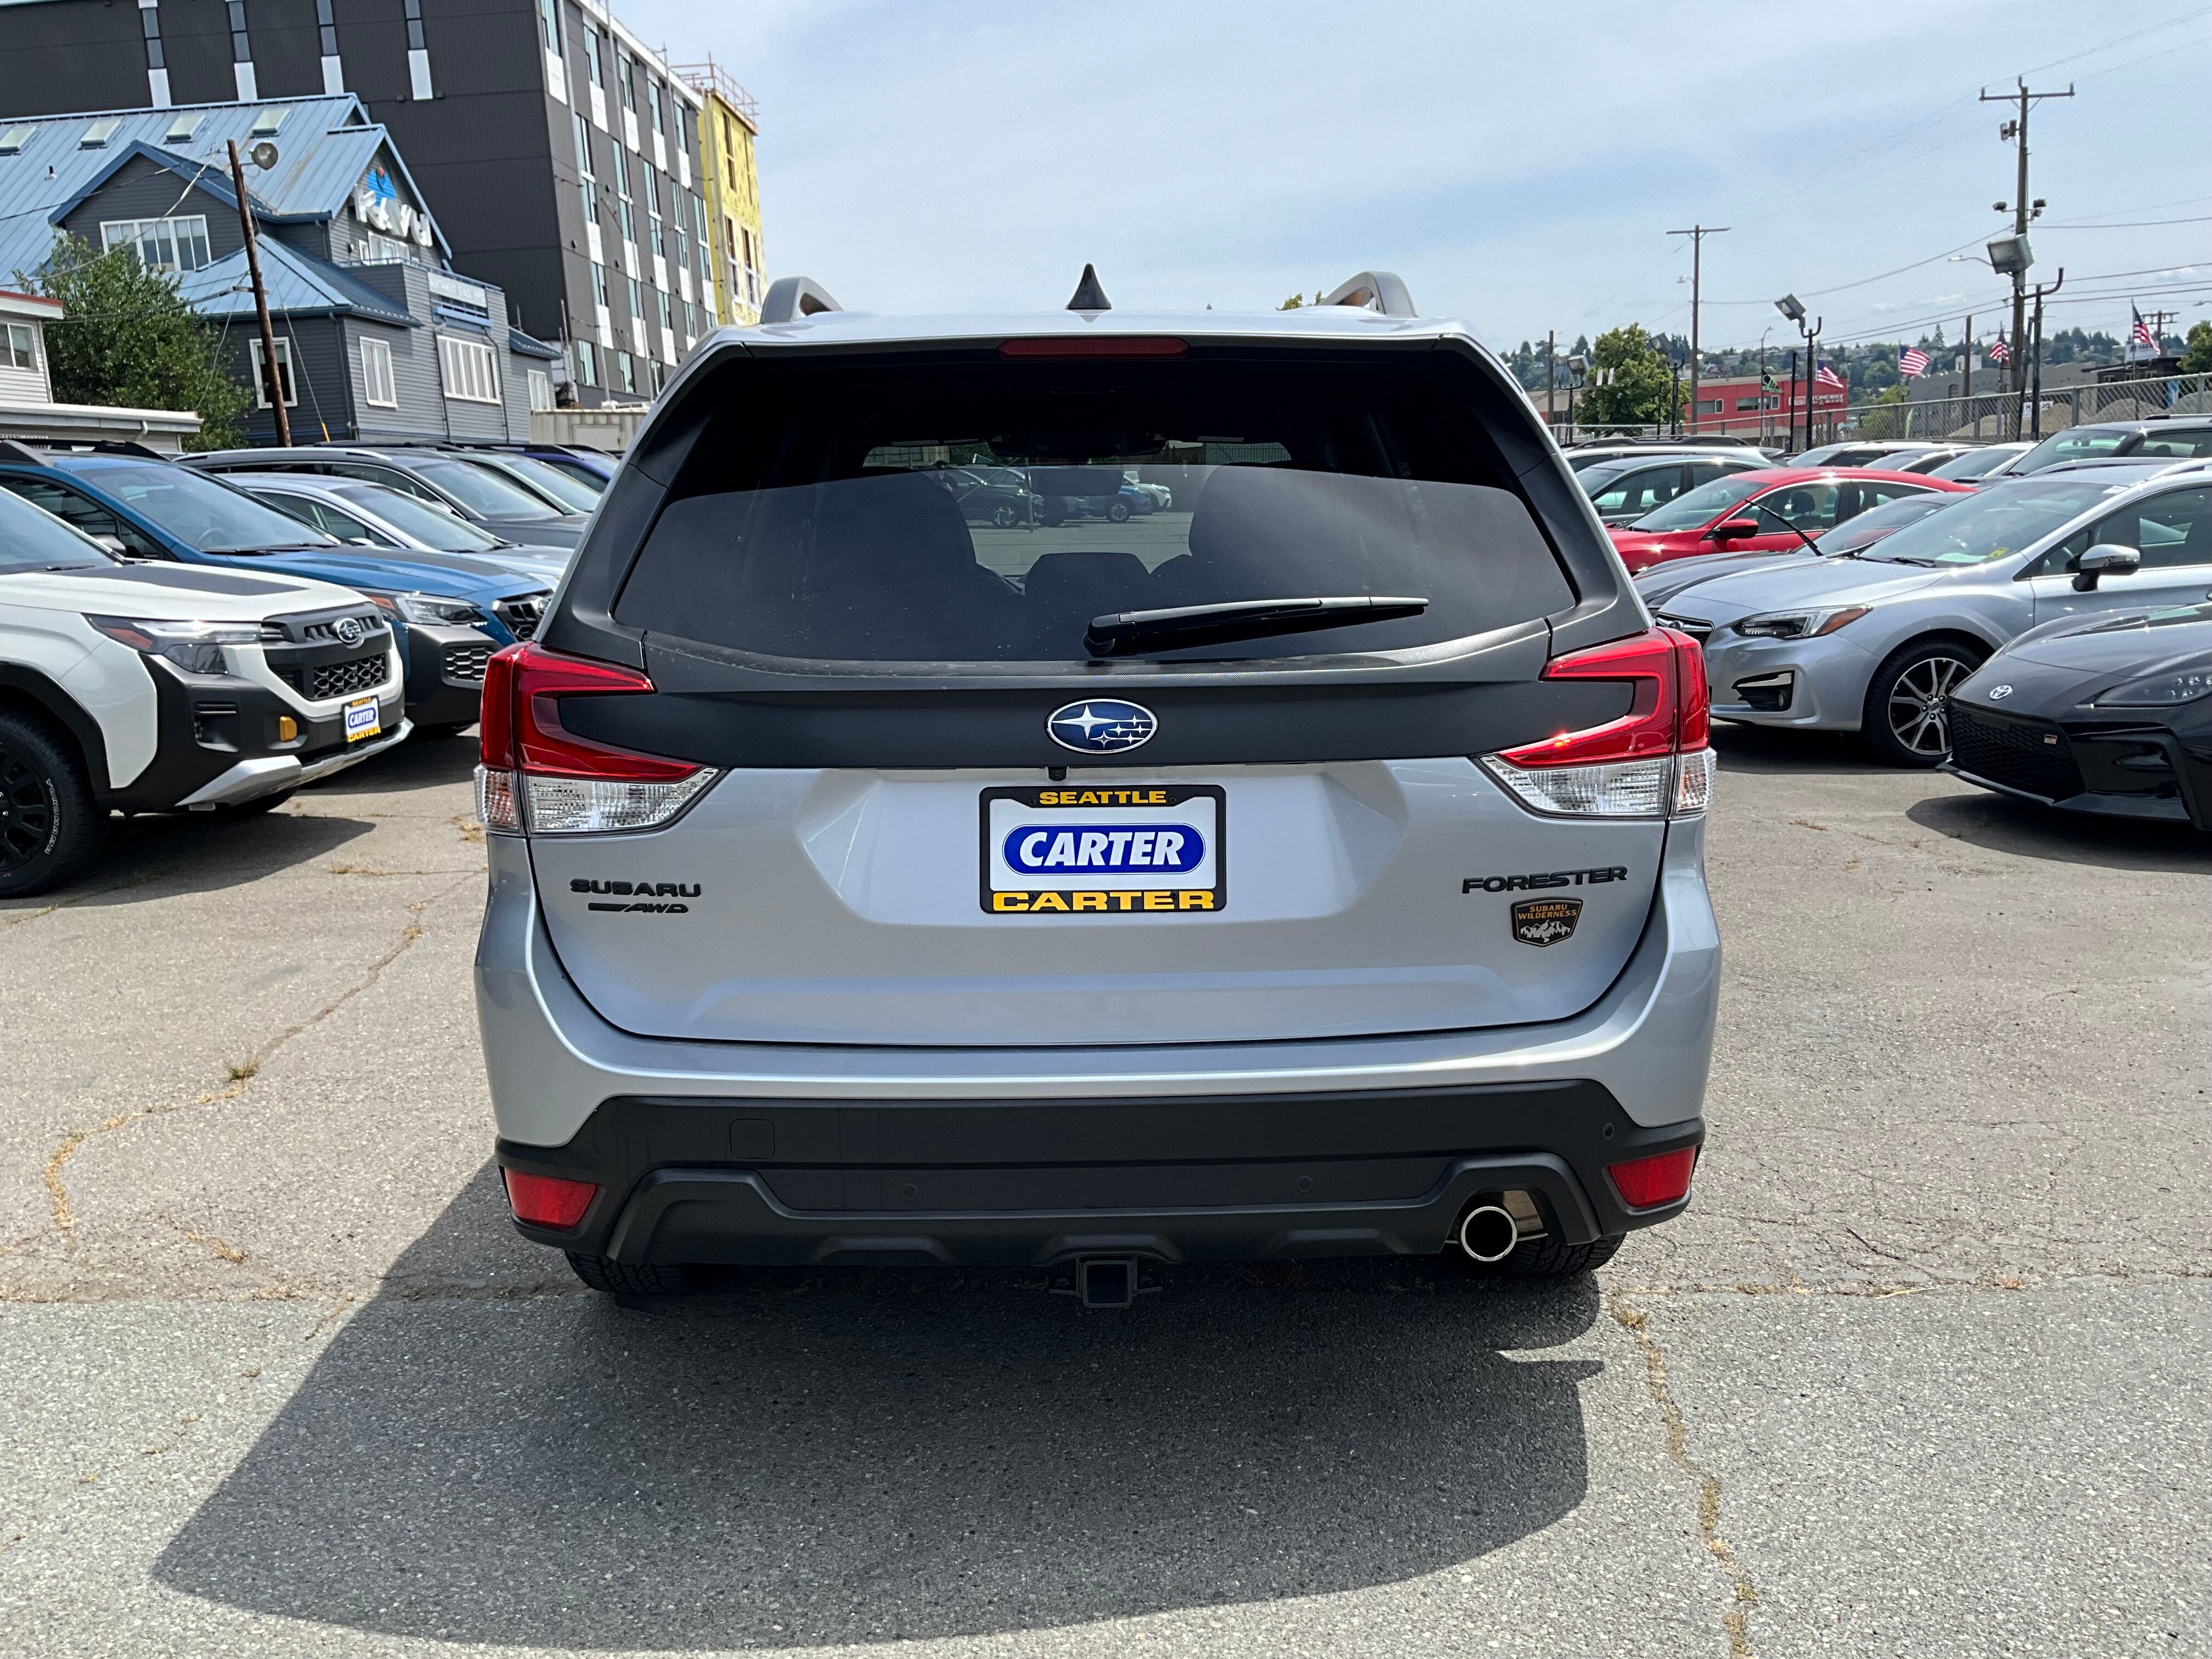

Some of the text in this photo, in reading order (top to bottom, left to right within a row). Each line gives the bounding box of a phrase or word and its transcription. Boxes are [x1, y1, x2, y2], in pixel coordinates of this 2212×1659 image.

[349, 710, 374, 726] CARTER
[348, 726, 381, 743] CARTER
[1039, 791, 1166, 804] SEATTLE
[44, 778, 60, 854] YOKOHAMA
[1019, 831, 1184, 866] CARTER
[570, 879, 701, 897] SUBARU
[1462, 865, 1628, 894] FORESTER
[624, 903, 689, 913] AWD
[993, 891, 1214, 911] CARTER
[1529, 904, 1567, 913] SUBARU
[1518, 909, 1577, 919] WILDERNESS
